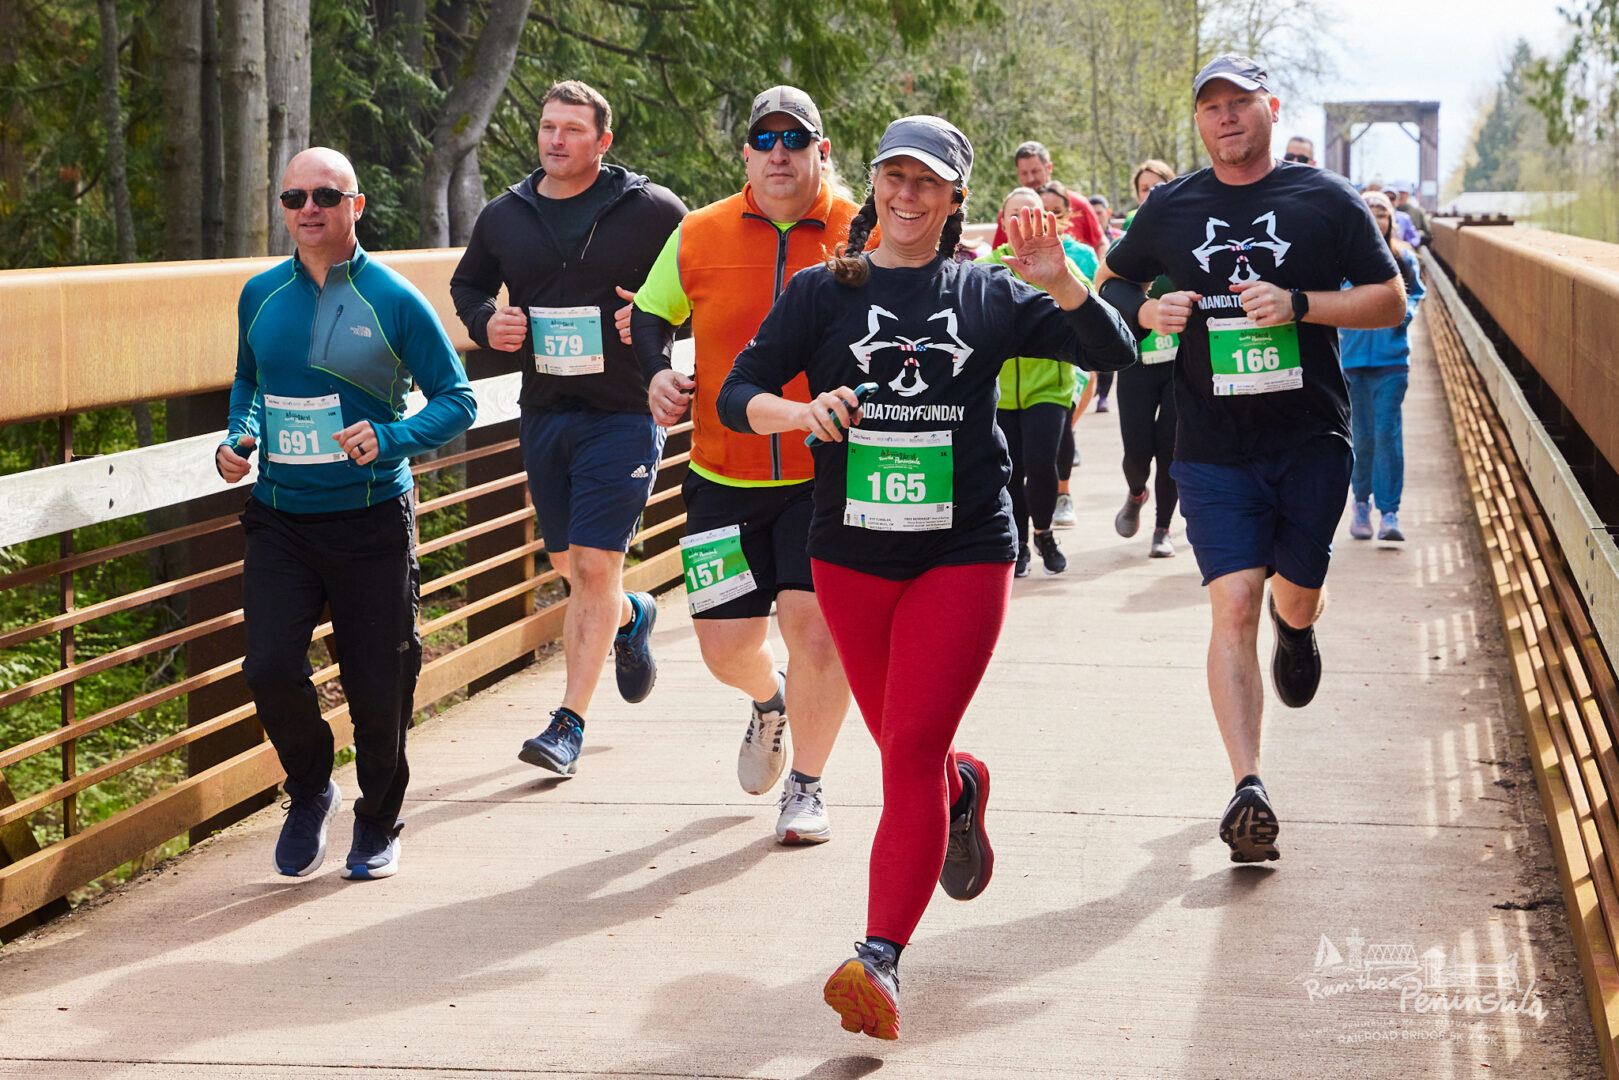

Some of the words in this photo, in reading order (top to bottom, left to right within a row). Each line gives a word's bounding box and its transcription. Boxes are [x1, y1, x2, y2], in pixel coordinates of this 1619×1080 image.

[544, 334, 584, 356] 579
[1232, 346, 1280, 373] 166
[278, 429, 320, 455] 691
[867, 471, 927, 502] 165
[686, 558, 725, 590] 157
